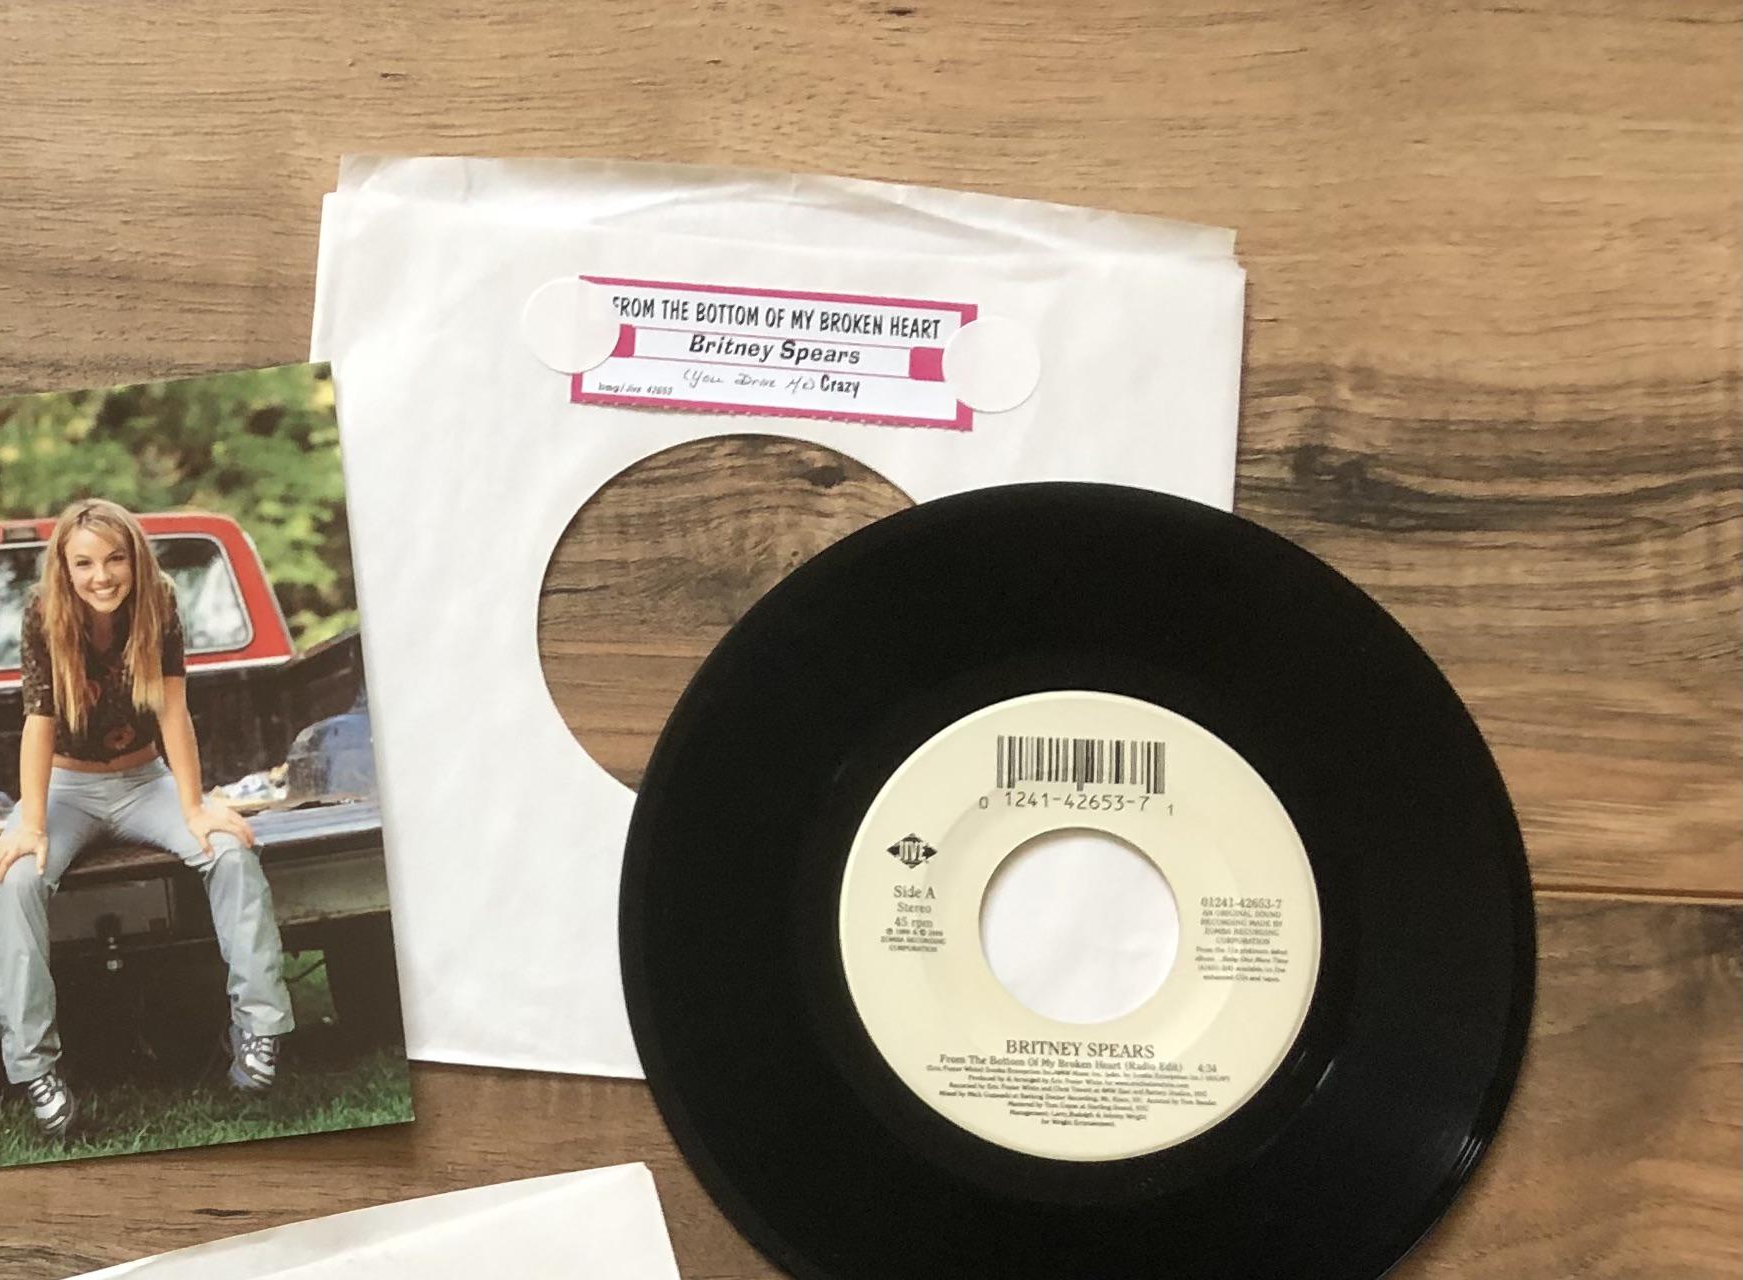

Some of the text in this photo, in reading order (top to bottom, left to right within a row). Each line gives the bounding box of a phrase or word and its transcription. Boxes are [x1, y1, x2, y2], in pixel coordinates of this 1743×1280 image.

[662, 299, 690, 321] THE
[696, 302, 759, 327] BOTTOM
[765, 307, 786, 329] OF
[791, 308, 815, 330] MY
[820, 311, 883, 336] BROKEN
[890, 315, 942, 340] HEART
[689, 333, 861, 366] Britney Spears
[820, 374, 861, 399] Crazy
[978, 795, 989, 810] 0
[1004, 790, 1151, 812] 1241-42653-7
[893, 884, 937, 900] Side A
[896, 900, 933, 914] Stereo
[894, 915, 934, 930] 45 rpm
[1006, 1039, 1155, 1060] BRITNEY SPEARS
[939, 1053, 966, 1064] From
[968, 1054, 988, 1065] The
[990, 1055, 1026, 1066] Bottom
[1027, 1056, 1040, 1067] Of
[1041, 1057, 1056, 1069] My
[1057, 1058, 1092, 1069] Broken
[1094, 1060, 1122, 1070] Heart
